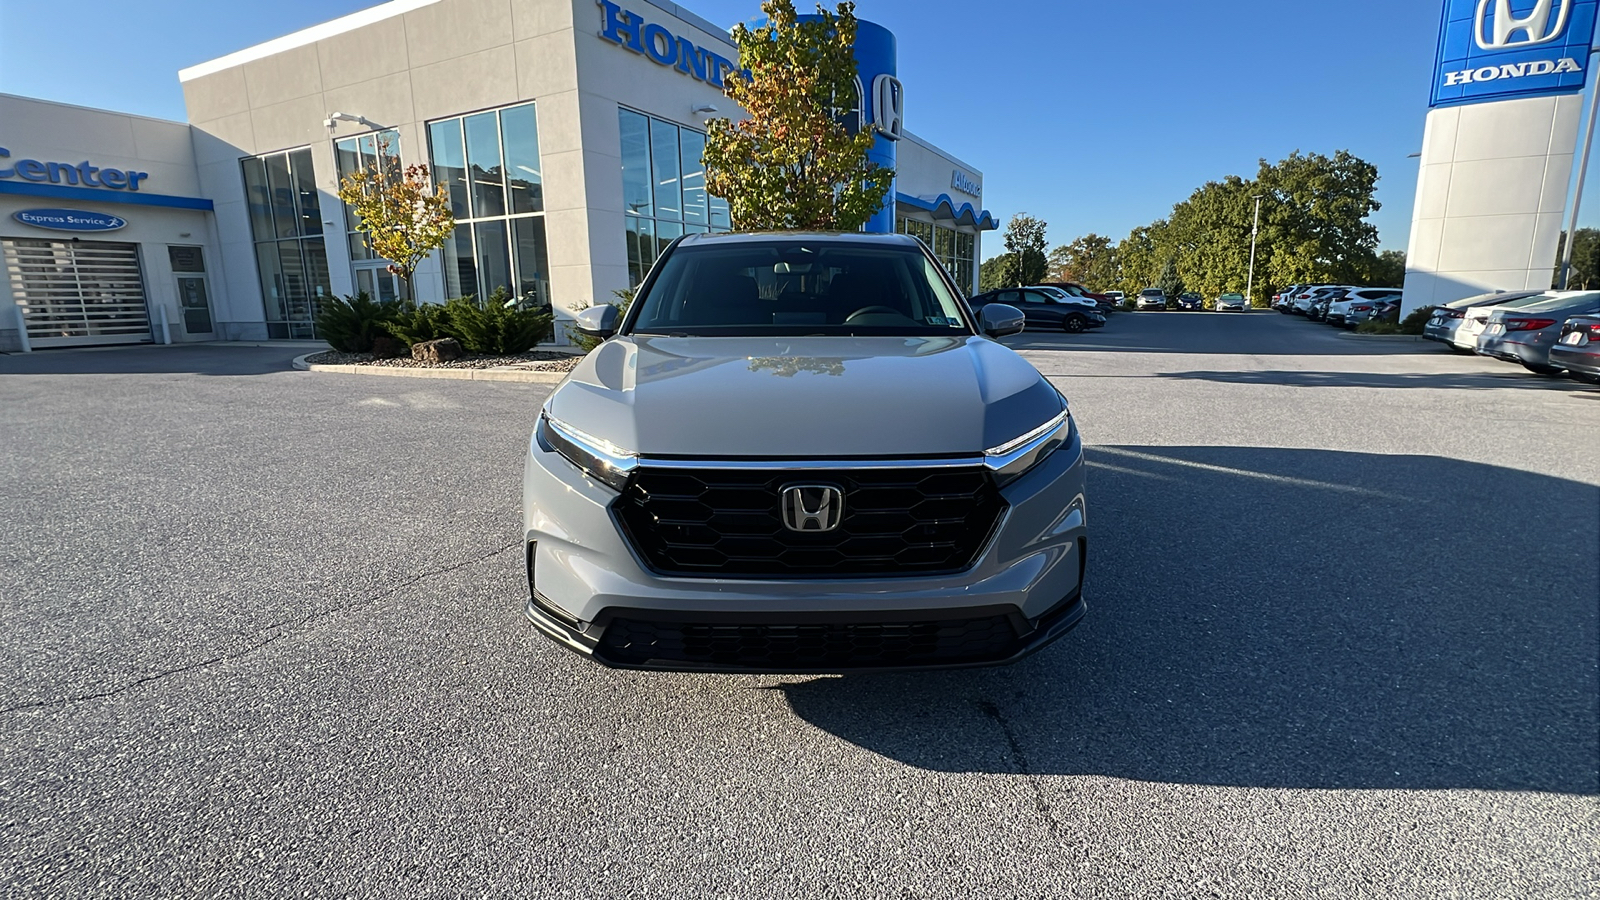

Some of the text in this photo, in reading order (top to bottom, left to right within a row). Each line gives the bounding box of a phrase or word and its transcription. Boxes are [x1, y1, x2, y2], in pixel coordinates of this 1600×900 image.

[1444, 57, 1582, 86] HONDA
[21, 213, 105, 225] Express Service
